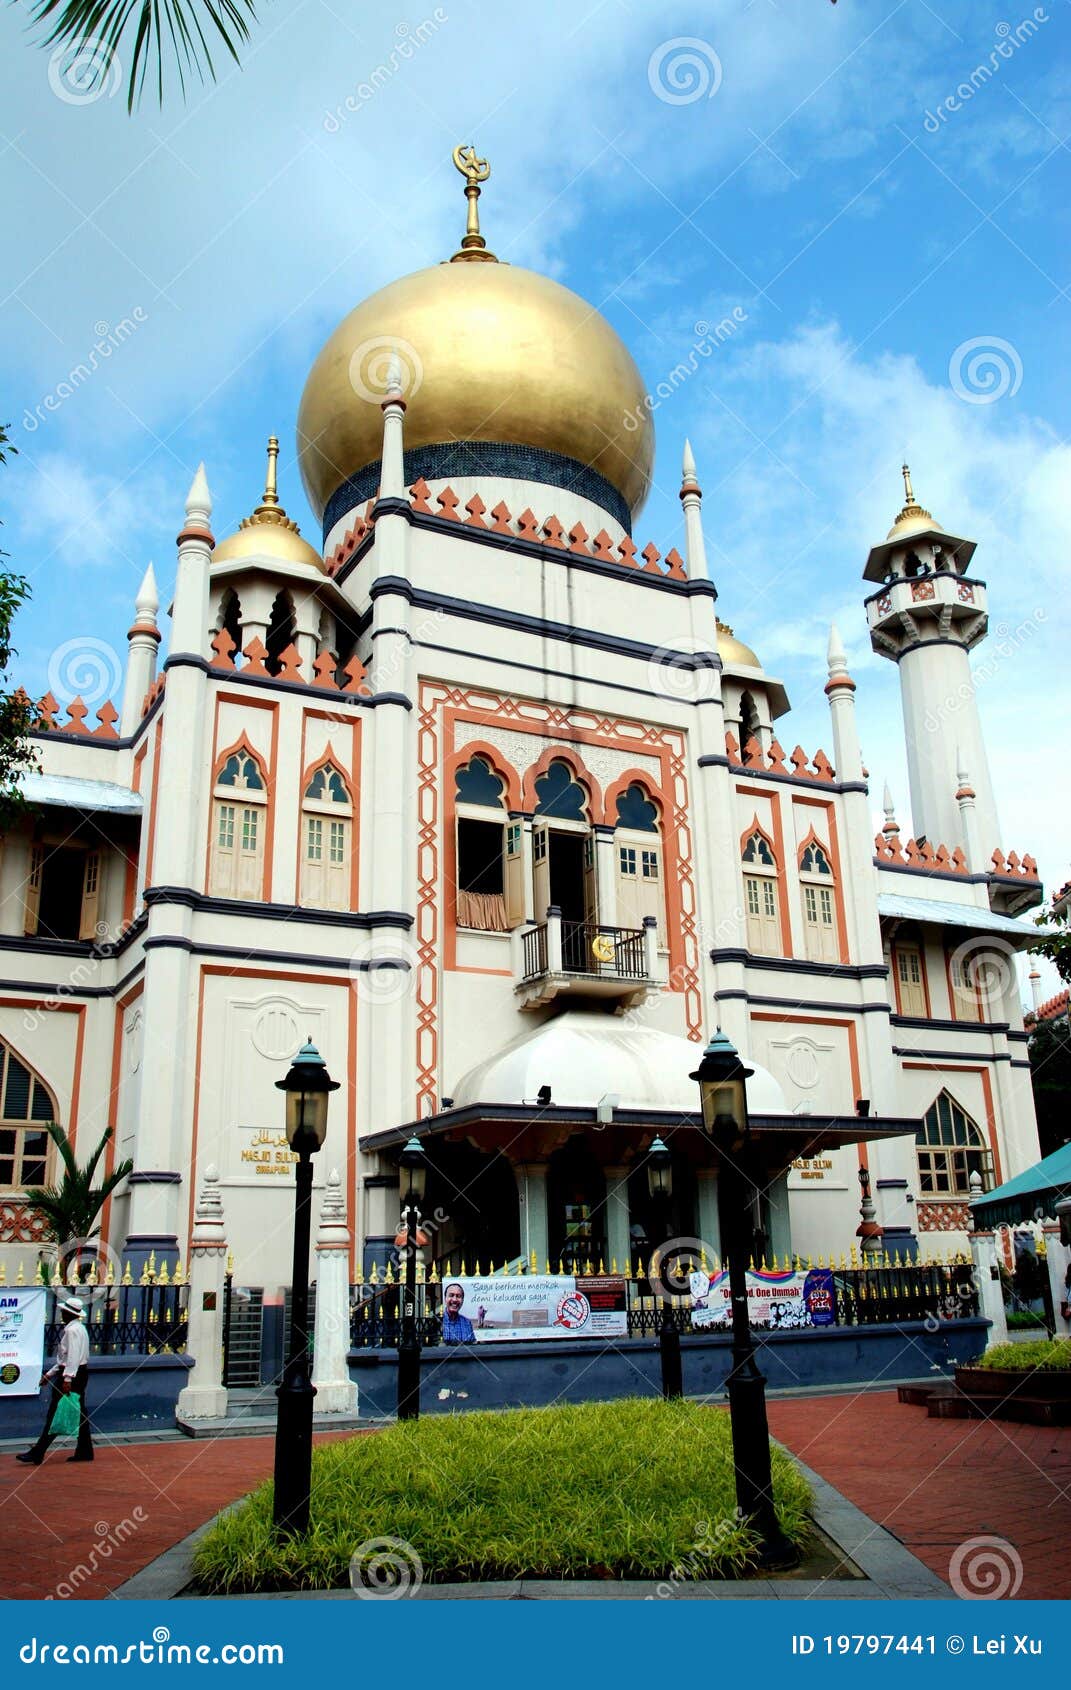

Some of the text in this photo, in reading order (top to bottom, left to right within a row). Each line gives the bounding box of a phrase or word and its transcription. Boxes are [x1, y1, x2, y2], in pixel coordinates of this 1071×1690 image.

[241, 1150, 300, 1163] MASJID SULTA
[812, 1159, 833, 1170] SULTAN
[756, 1287, 770, 1297] One
